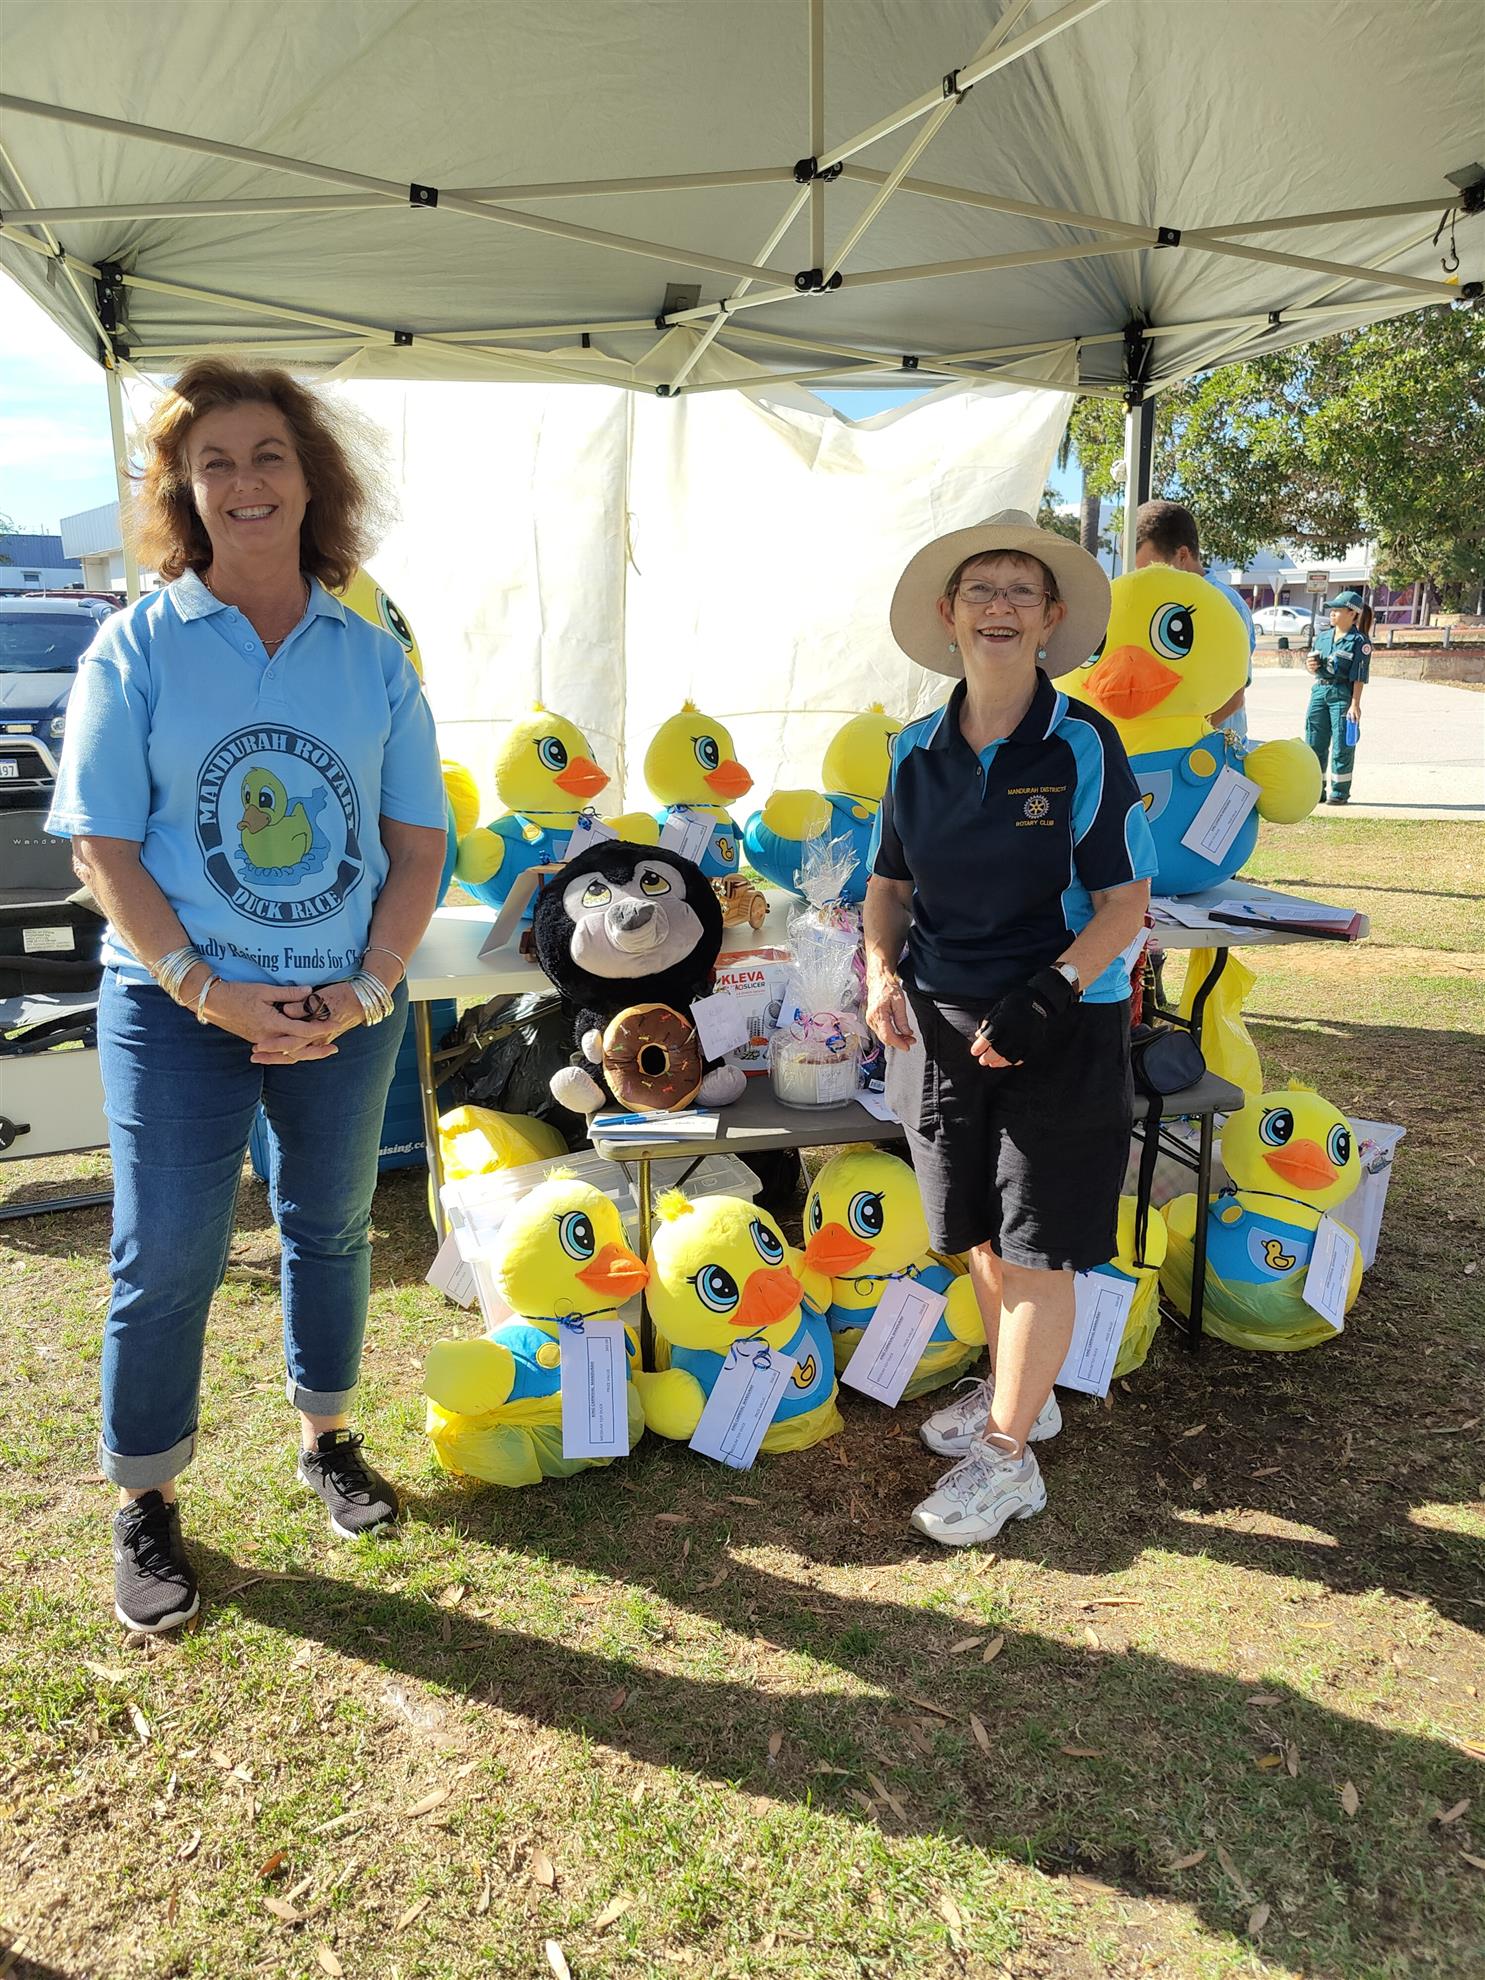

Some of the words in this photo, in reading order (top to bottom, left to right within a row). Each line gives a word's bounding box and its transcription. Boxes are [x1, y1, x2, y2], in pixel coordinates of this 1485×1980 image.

[200, 733, 288, 825] MANDURAH
[294, 738, 355, 829] ROTARY
[1007, 786, 1039, 795] MANDURAH
[1015, 819, 1038, 827] ROTARY
[232, 887, 283, 919] DUCK
[291, 890, 341, 919] RACE
[195, 937, 226, 960] udly
[227, 942, 279, 972] Raising
[284, 947, 324, 969] Funds
[327, 948, 344, 969] for
[721, 970, 765, 986] KLEVA
